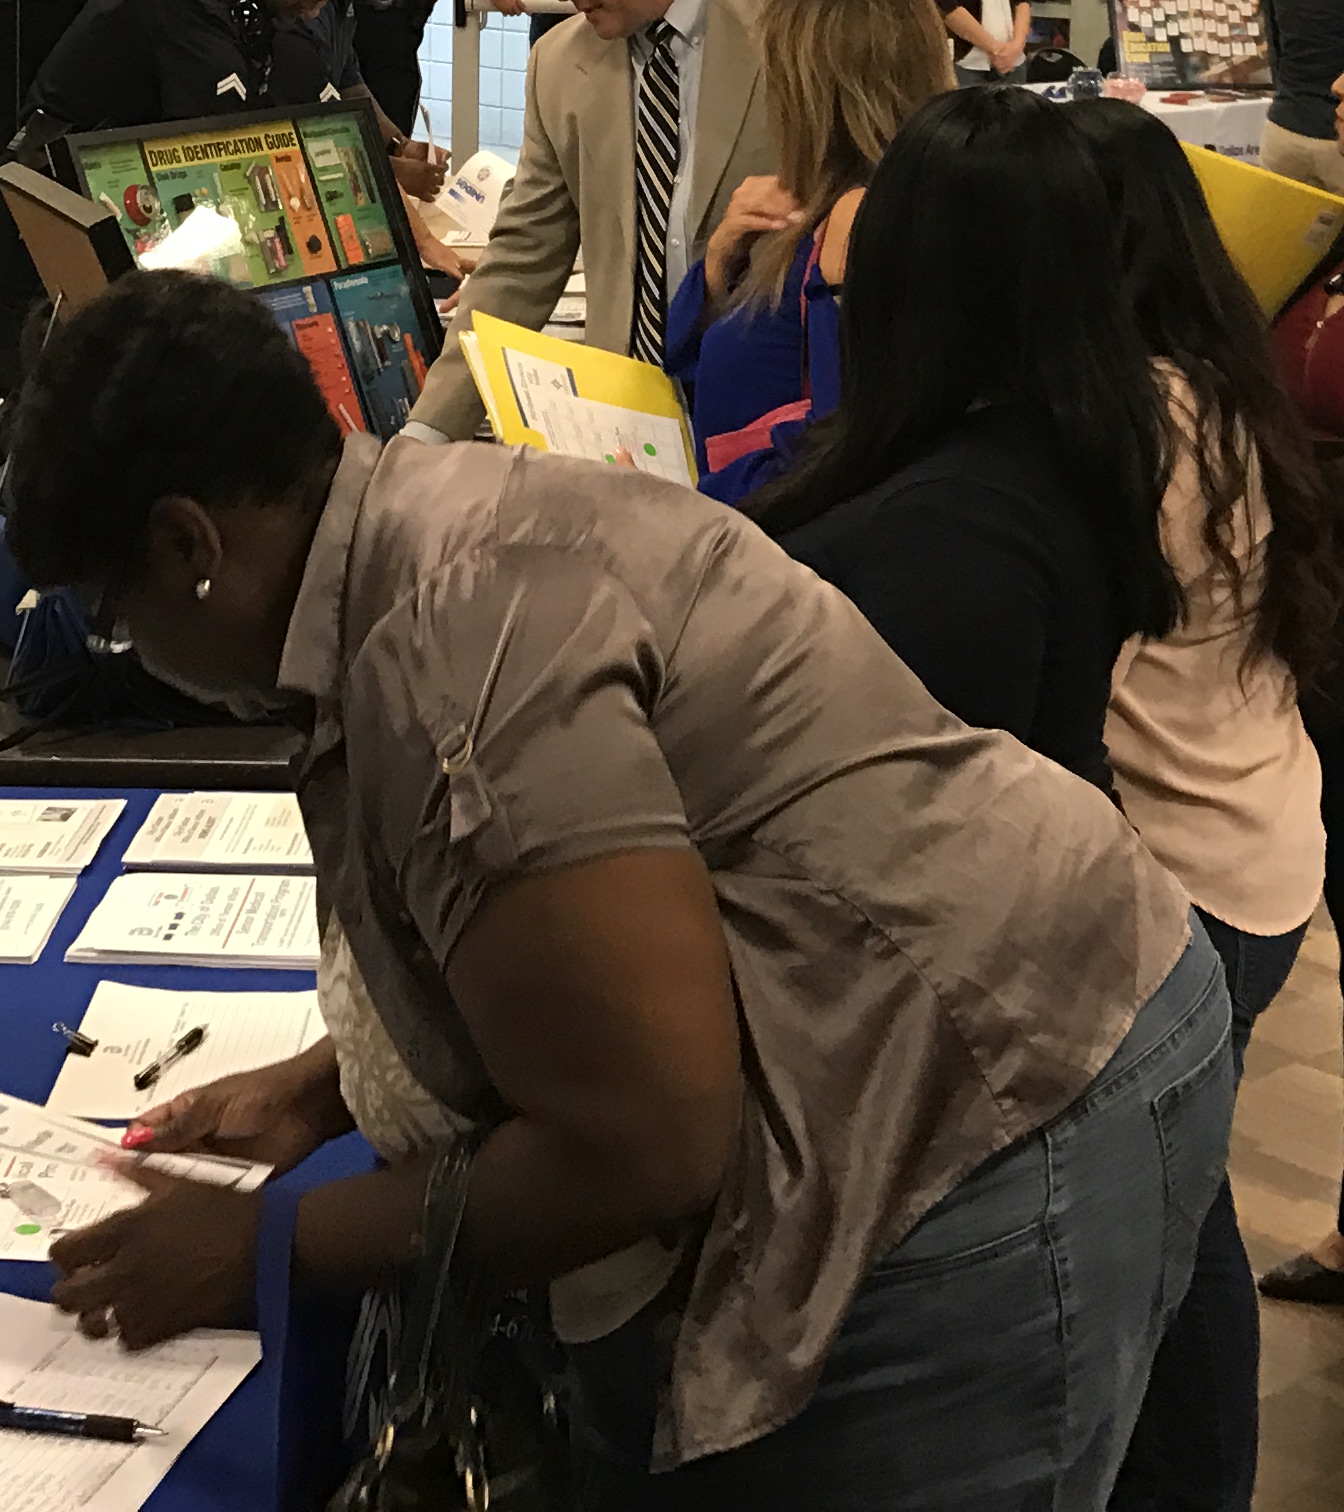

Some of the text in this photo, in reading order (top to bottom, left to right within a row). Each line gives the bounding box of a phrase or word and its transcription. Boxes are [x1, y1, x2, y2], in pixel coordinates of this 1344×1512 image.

[147, 147, 182, 167] DRUG
[182, 137, 264, 162] IDENTIFICATION
[264, 131, 297, 150] GUIDE
